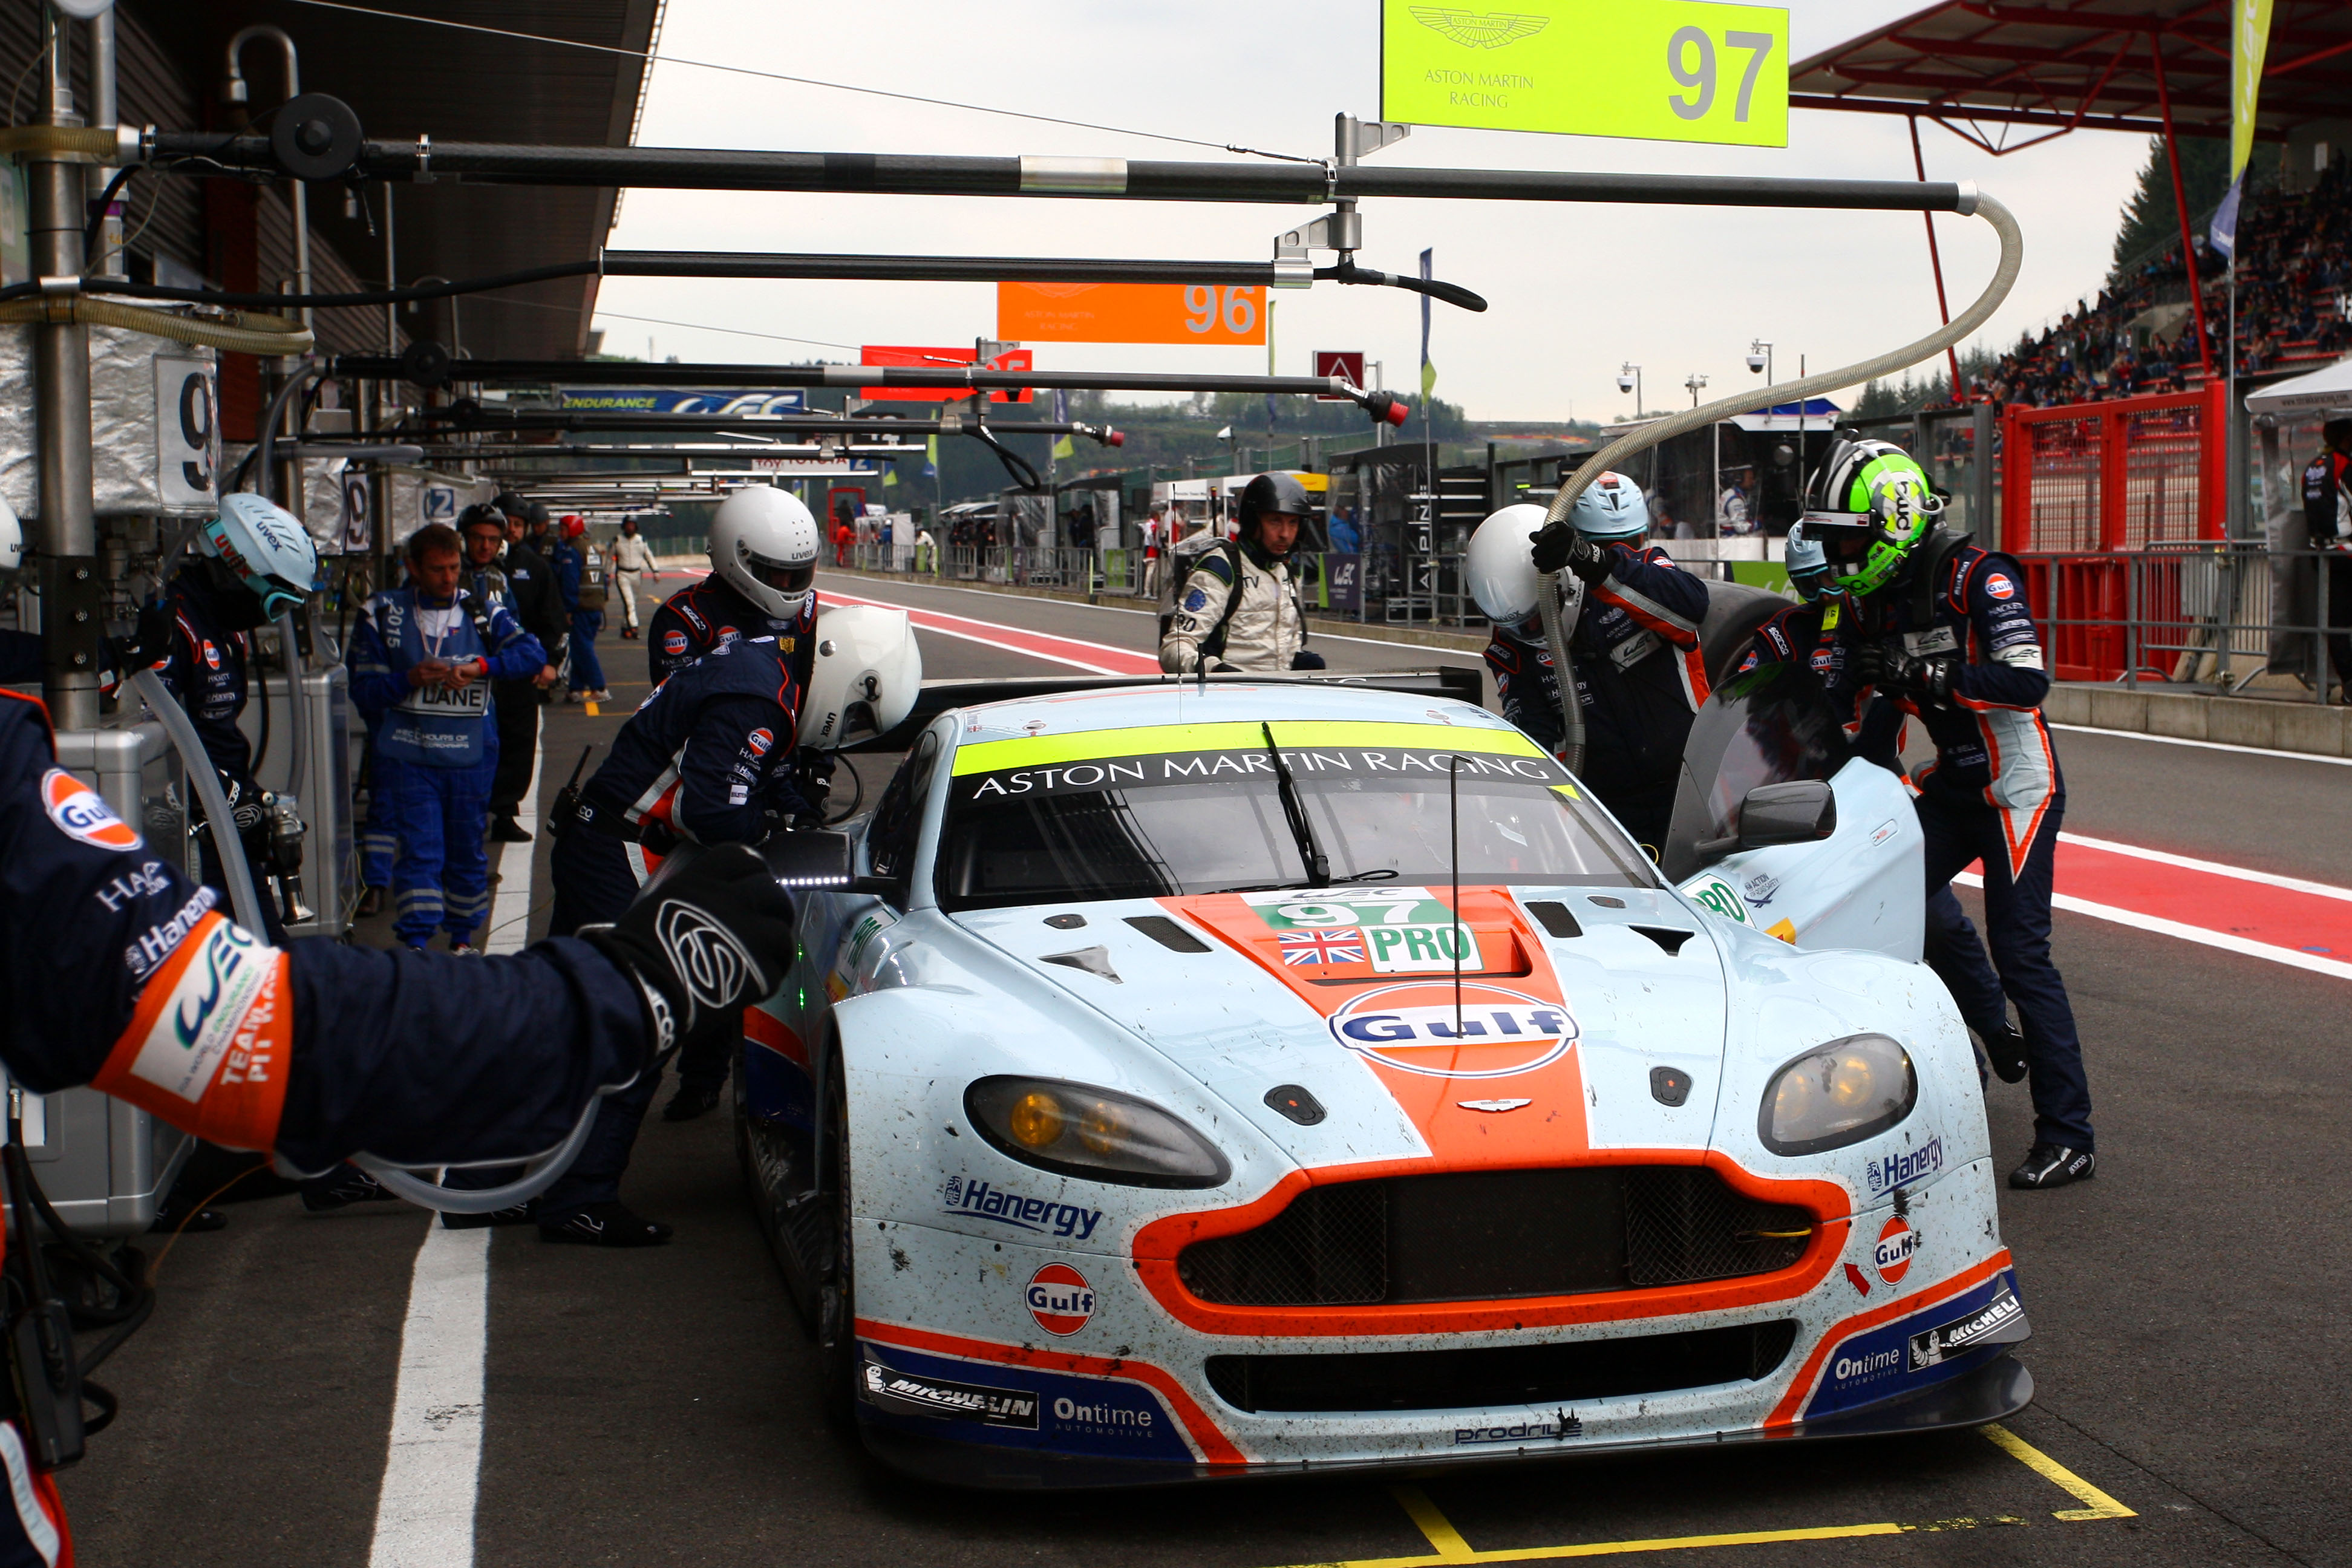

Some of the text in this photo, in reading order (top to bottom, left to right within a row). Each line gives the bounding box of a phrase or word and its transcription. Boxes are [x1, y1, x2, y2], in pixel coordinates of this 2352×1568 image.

[1452, 16, 1507, 29] ASTON MARTIN
[1425, 70, 1534, 89] ASTON MARTIN
[1667, 26, 1773, 122] 97
[1450, 91, 1508, 108] RACING
[1184, 286, 1256, 333] 96
[563, 397, 657, 409] ENDURANCE
[255, 520, 283, 553] uvex
[791, 549, 814, 560] uvex
[1988, 582, 2013, 592] Gulf
[386, 605, 405, 648] 2015
[1494, 610, 1523, 622] uvex
[1767, 627, 1789, 656] sparco
[422, 687, 482, 707] LANE
[820, 712, 837, 737] uvex
[751, 734, 771, 751] Gulf
[973, 750, 1550, 799] ASTON MARTIN RACING
[1751, 872, 1769, 888] ACTION
[1276, 900, 1420, 927] 97
[1376, 927, 1468, 962] PRO
[1341, 1010, 1566, 1043] Gulf
[1884, 1135, 1943, 1187] Hanergy
[961, 1178, 1103, 1240] Hanergy
[1875, 1235, 1915, 1266] Gulf
[1027, 1286, 1094, 1313] Gulf
[1834, 1348, 1900, 1380] Ontime
[1834, 1367, 1899, 1391] AUTOMOTIVE
[889, 1379, 1035, 1417] MICHELIN
[1053, 1397, 1153, 1427] Ontime
[1054, 1423, 1154, 1439] AUTOMOTIVE
